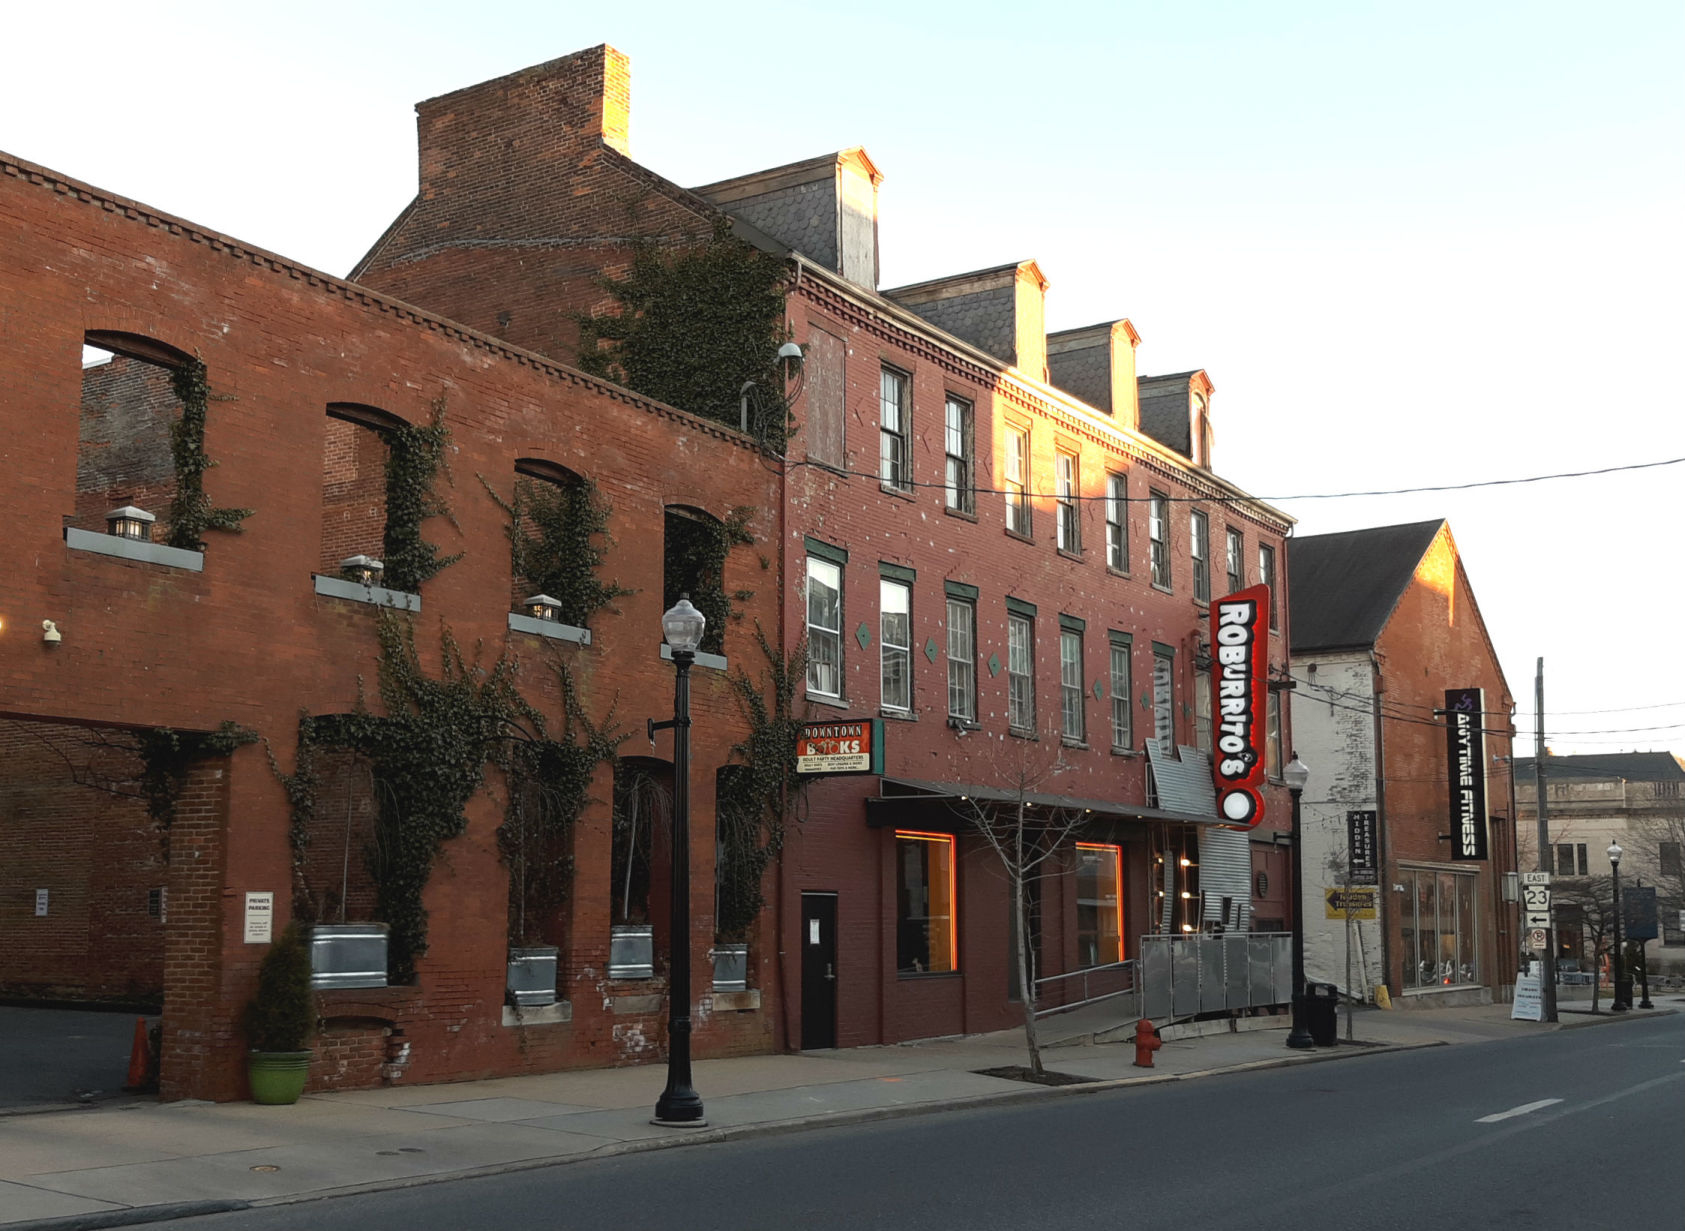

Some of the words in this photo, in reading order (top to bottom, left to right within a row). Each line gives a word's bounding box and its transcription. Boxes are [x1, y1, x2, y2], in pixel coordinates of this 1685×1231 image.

[1217, 604, 1253, 775] ROBURRITO'S
[804, 725, 861, 738] DOWNTOWN
[1457, 713, 1472, 786] ANYTIME
[1363, 814, 1371, 867] TREASURES
[1460, 790, 1476, 856] FITNESS
[1526, 890, 1547, 904] 23
[1527, 874, 1545, 882] EAST
